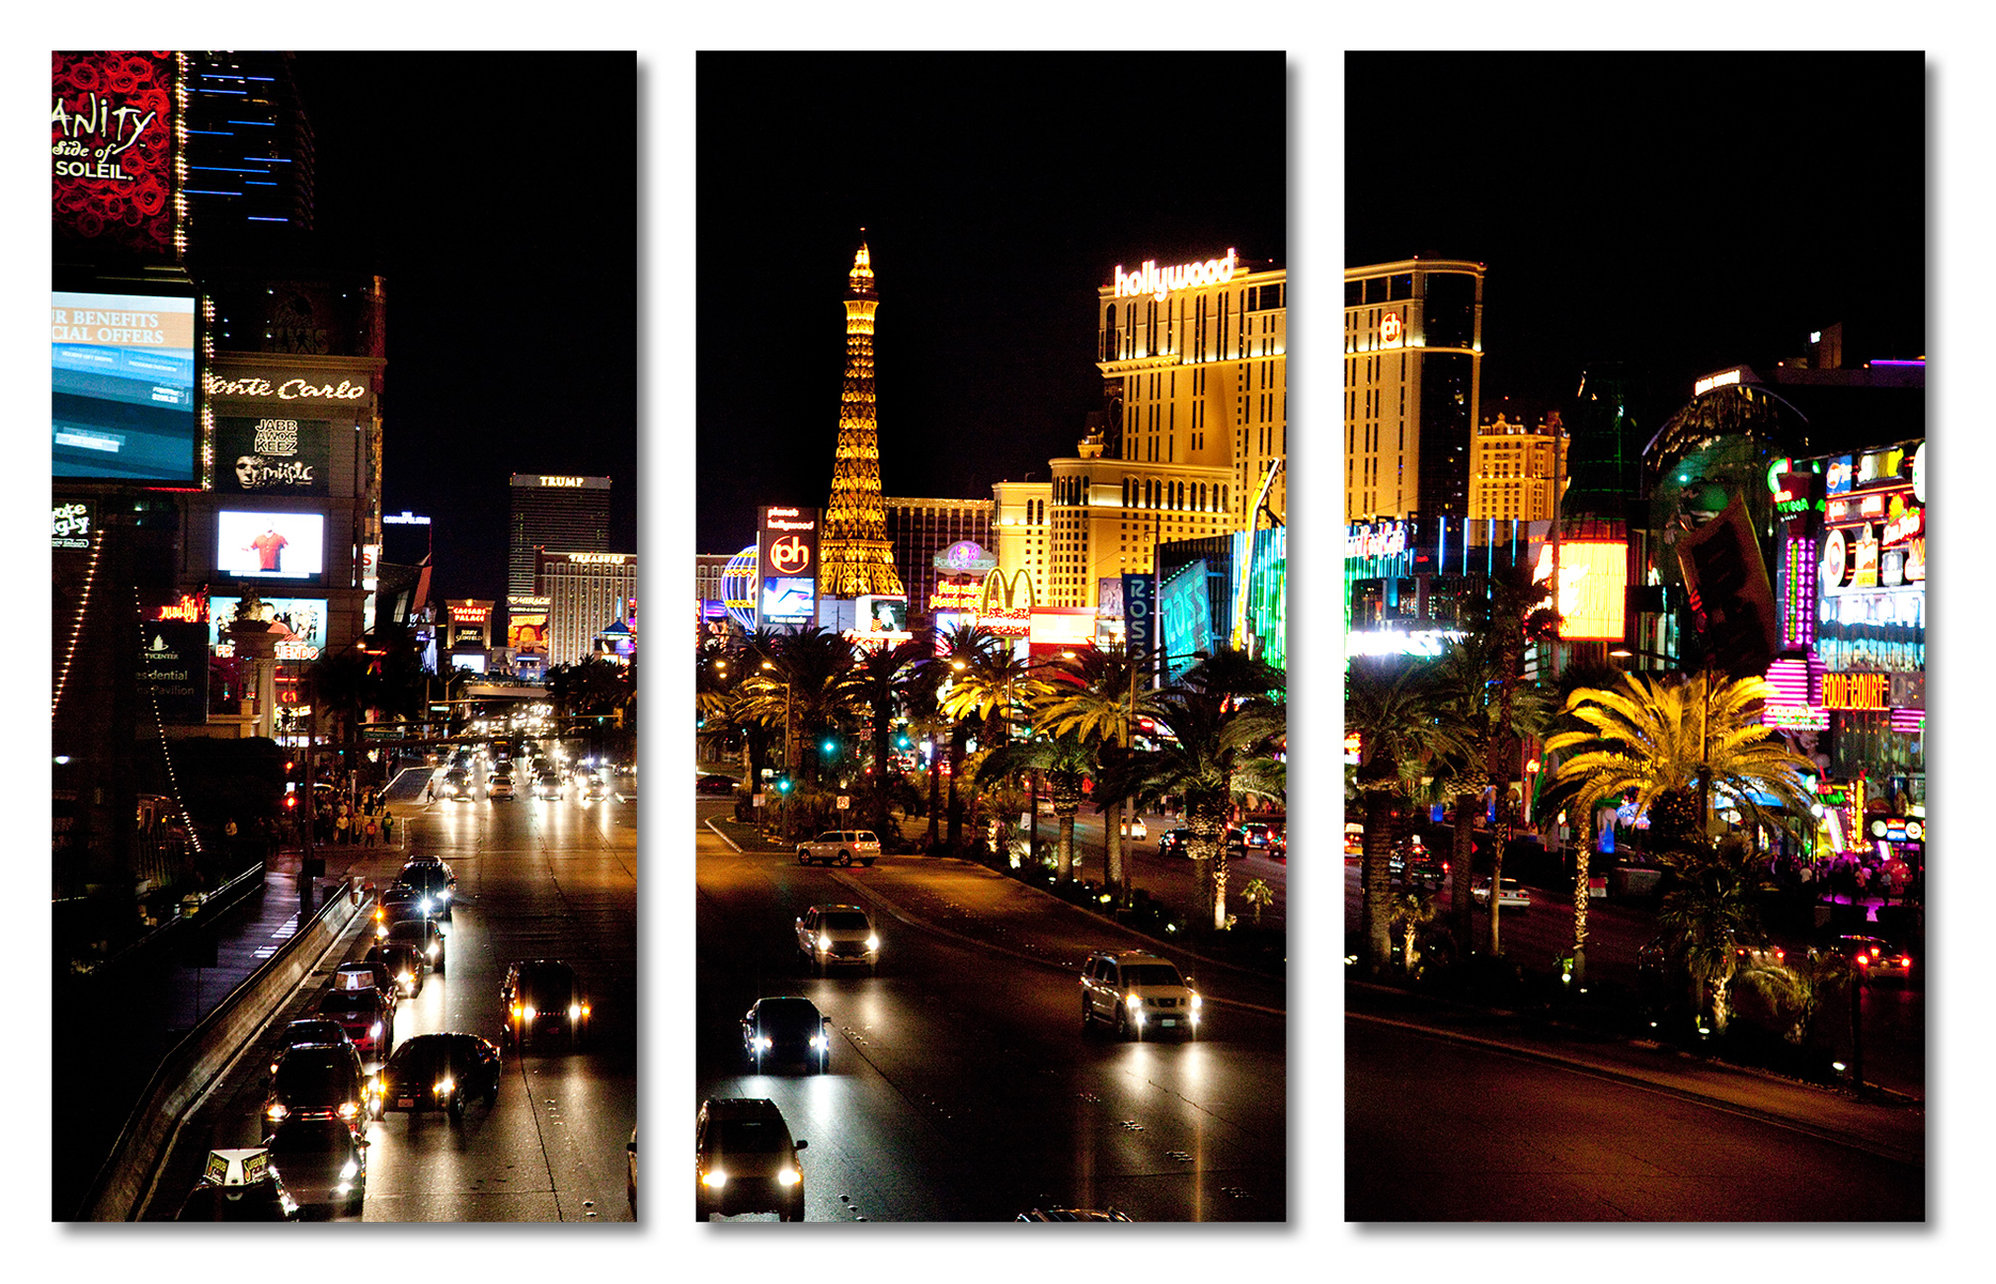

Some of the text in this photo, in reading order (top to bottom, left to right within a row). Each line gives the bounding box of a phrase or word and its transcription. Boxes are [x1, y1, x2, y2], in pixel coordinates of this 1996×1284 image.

[51, 141, 117, 164] Side of
[55, 160, 134, 181] SOLEIL.
[1114, 247, 1236, 303] hollywood
[73, 310, 158, 328] BENEFITS
[97, 326, 164, 344] OFFERS
[277, 379, 365, 400] Carlo
[255, 419, 298, 433] JABB
[255, 431, 298, 442] AWOC
[254, 441, 298, 454] KEEZ
[539, 475, 584, 488] TRUMP
[767, 506, 799, 519] planet
[767, 519, 815, 532] hollywood
[568, 554, 626, 564] TREASURE
[453, 607, 487, 615] CAESARS
[454, 614, 485, 622] PALACE
[1822, 672, 1885, 708] FOOD COURT
